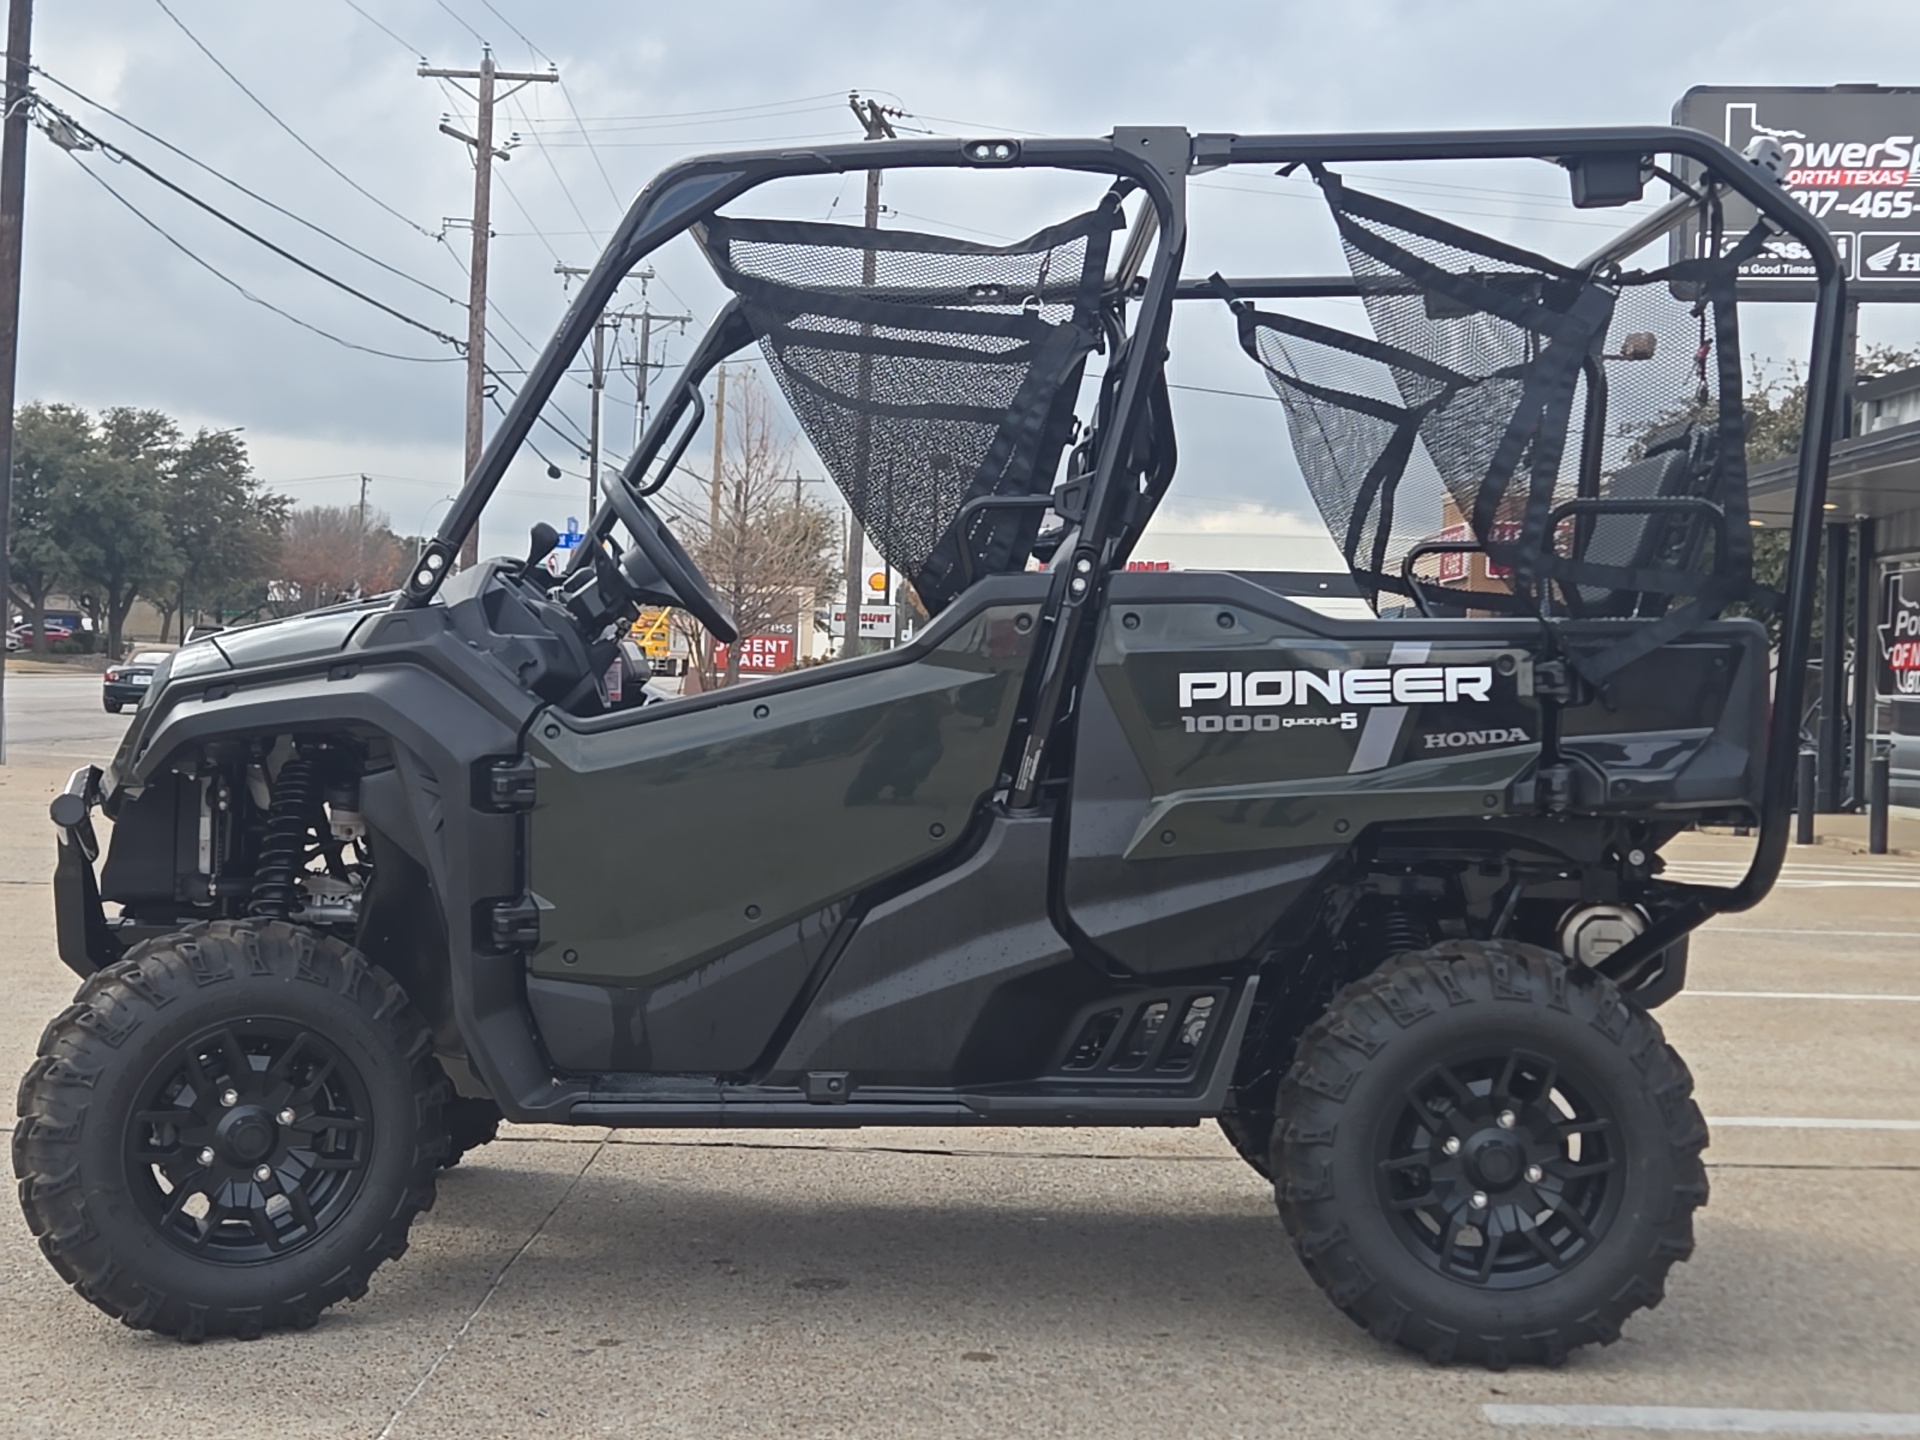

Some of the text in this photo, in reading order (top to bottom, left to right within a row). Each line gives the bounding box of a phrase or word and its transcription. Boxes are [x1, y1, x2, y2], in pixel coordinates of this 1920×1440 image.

[1788, 170, 1906, 185] ORTH TEXAS
[1750, 263, 1781, 275] Good
[1782, 264, 1817, 275] Times
[834, 612, 892, 624] DIOUNT
[715, 639, 789, 654] UGENT
[728, 654, 776, 668] ARE
[1179, 666, 1493, 708] PIONEER
[1181, 713, 1280, 733] 1000
[1424, 727, 1530, 749] HONDA
